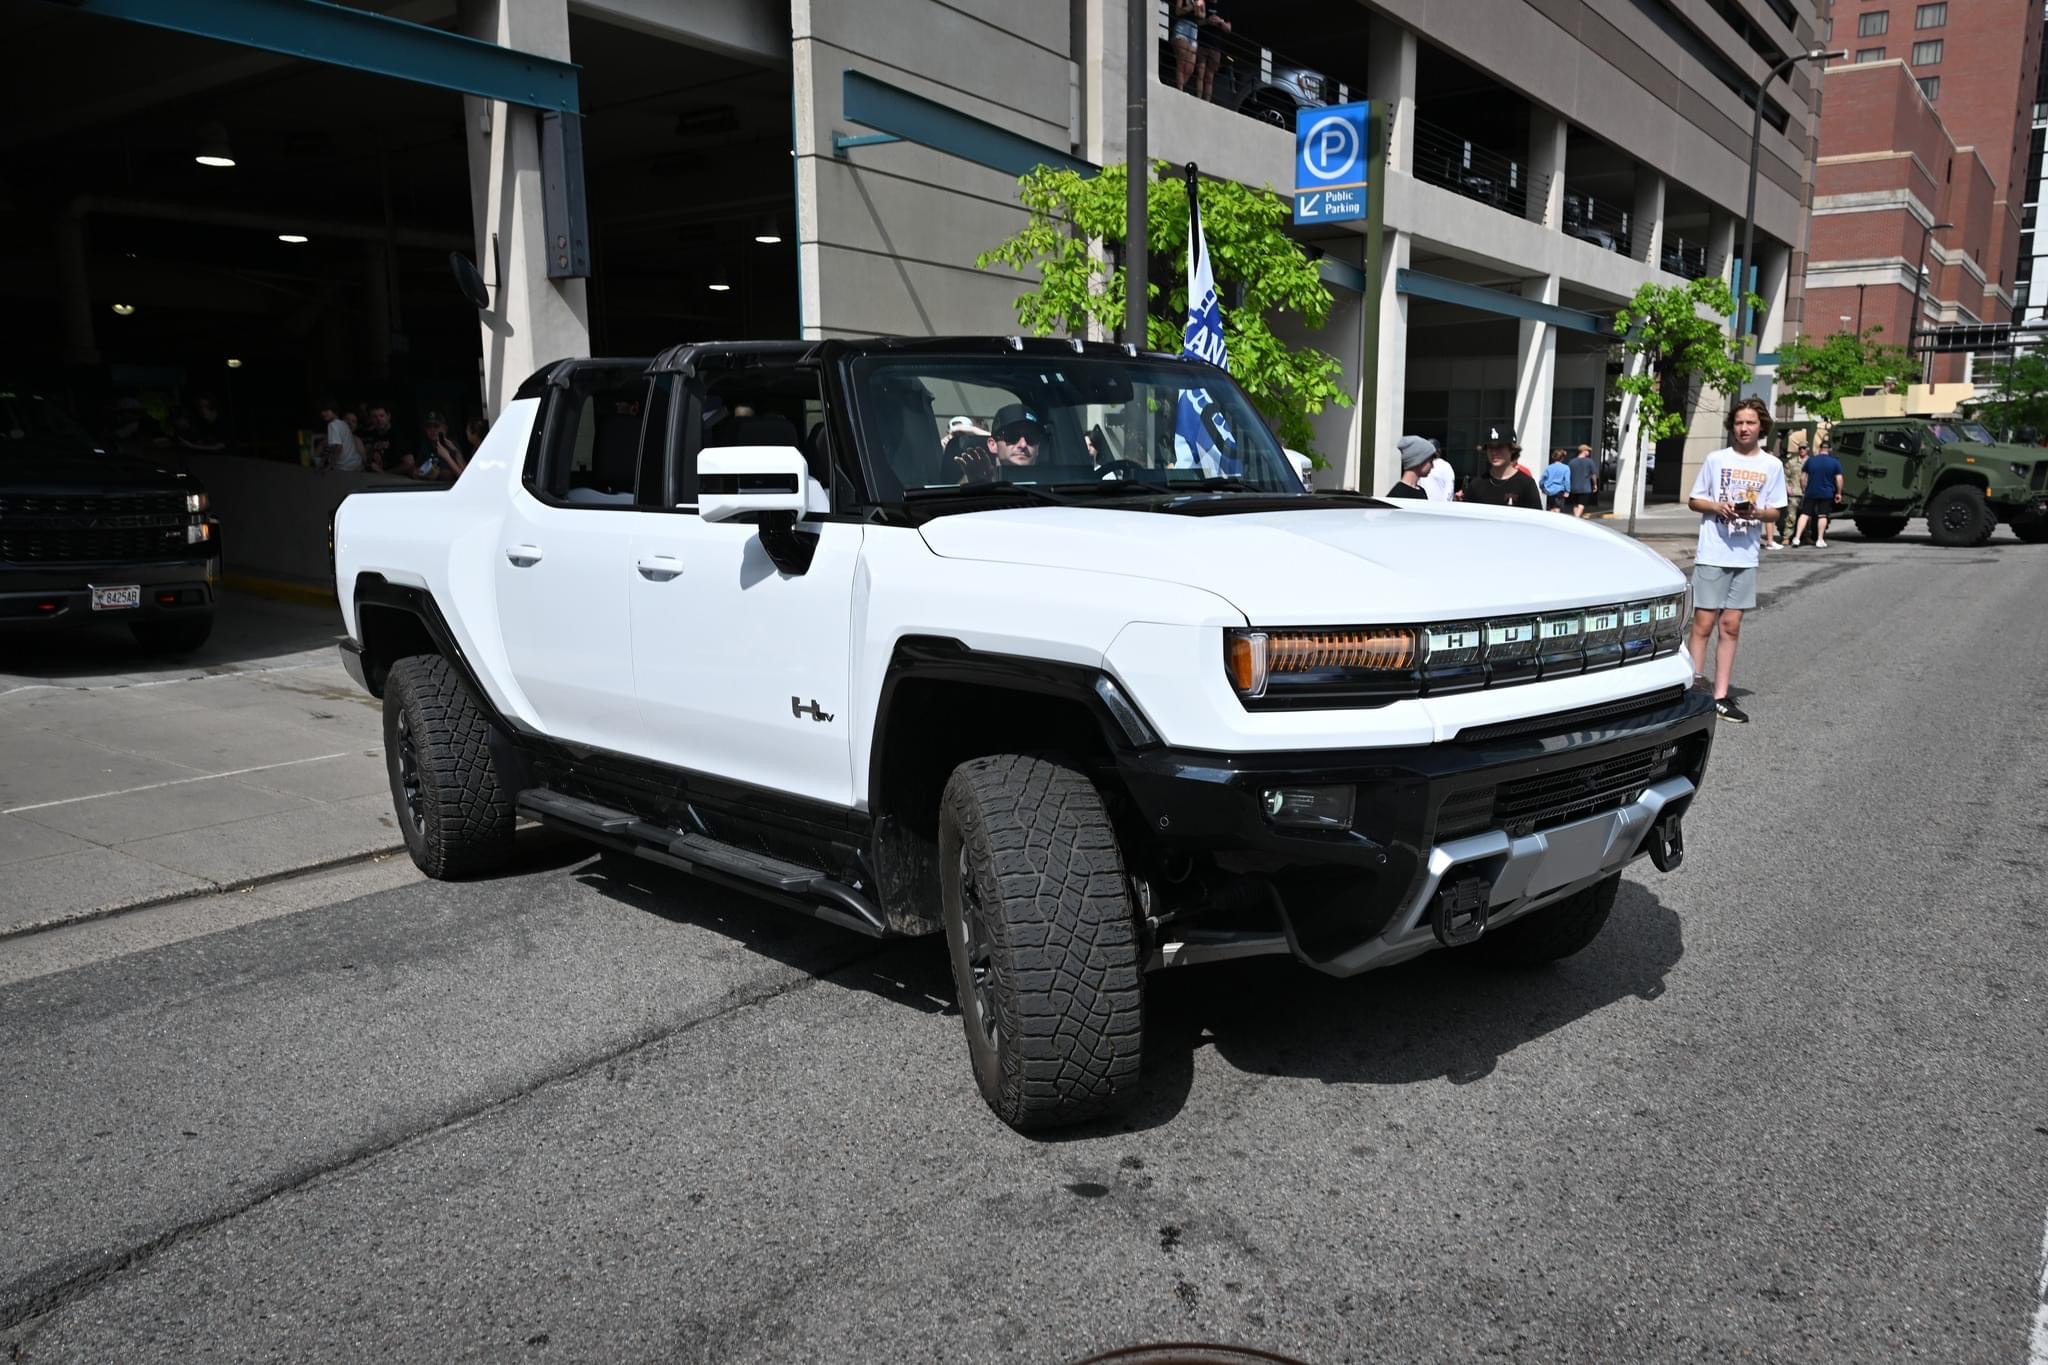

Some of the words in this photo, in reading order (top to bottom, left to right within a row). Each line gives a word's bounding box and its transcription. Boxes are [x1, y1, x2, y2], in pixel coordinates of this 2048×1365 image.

[1320, 130, 1346, 167] P
[1325, 191, 1354, 202] Public
[1325, 203, 1360, 215] Parking
[1447, 605, 1673, 649] HUMMER
